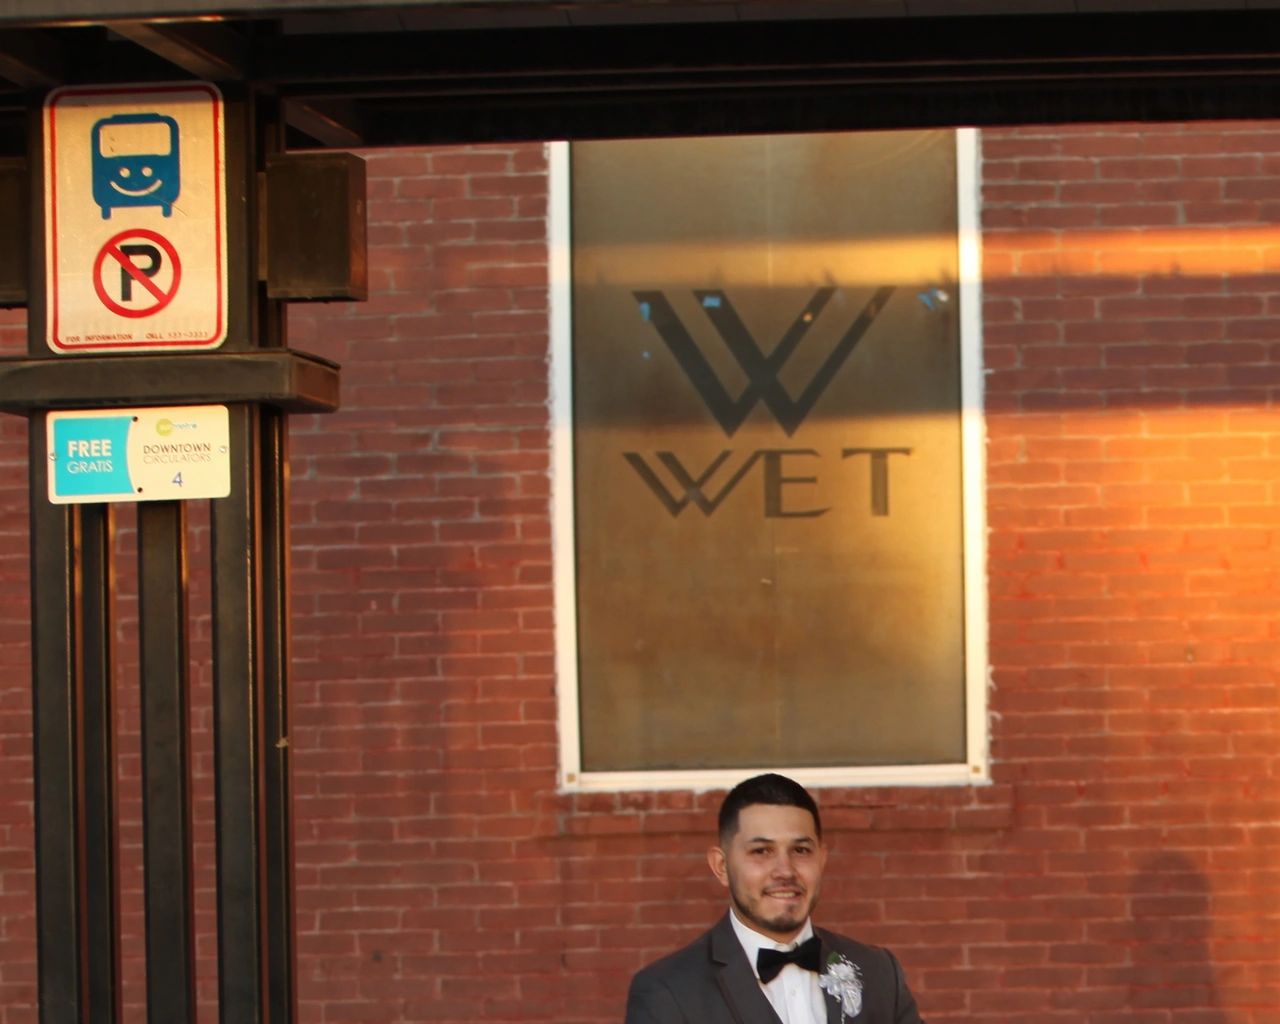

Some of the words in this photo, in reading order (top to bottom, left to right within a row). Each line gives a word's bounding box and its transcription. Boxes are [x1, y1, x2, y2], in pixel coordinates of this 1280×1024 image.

[120, 244, 162, 302] P
[631, 286, 898, 439] W
[67, 439, 112, 457] FREE
[143, 443, 212, 455] DOWNTOWN
[67, 460, 113, 474] GRATIS
[172, 472, 183, 488] 4
[622, 447, 912, 519] WET
